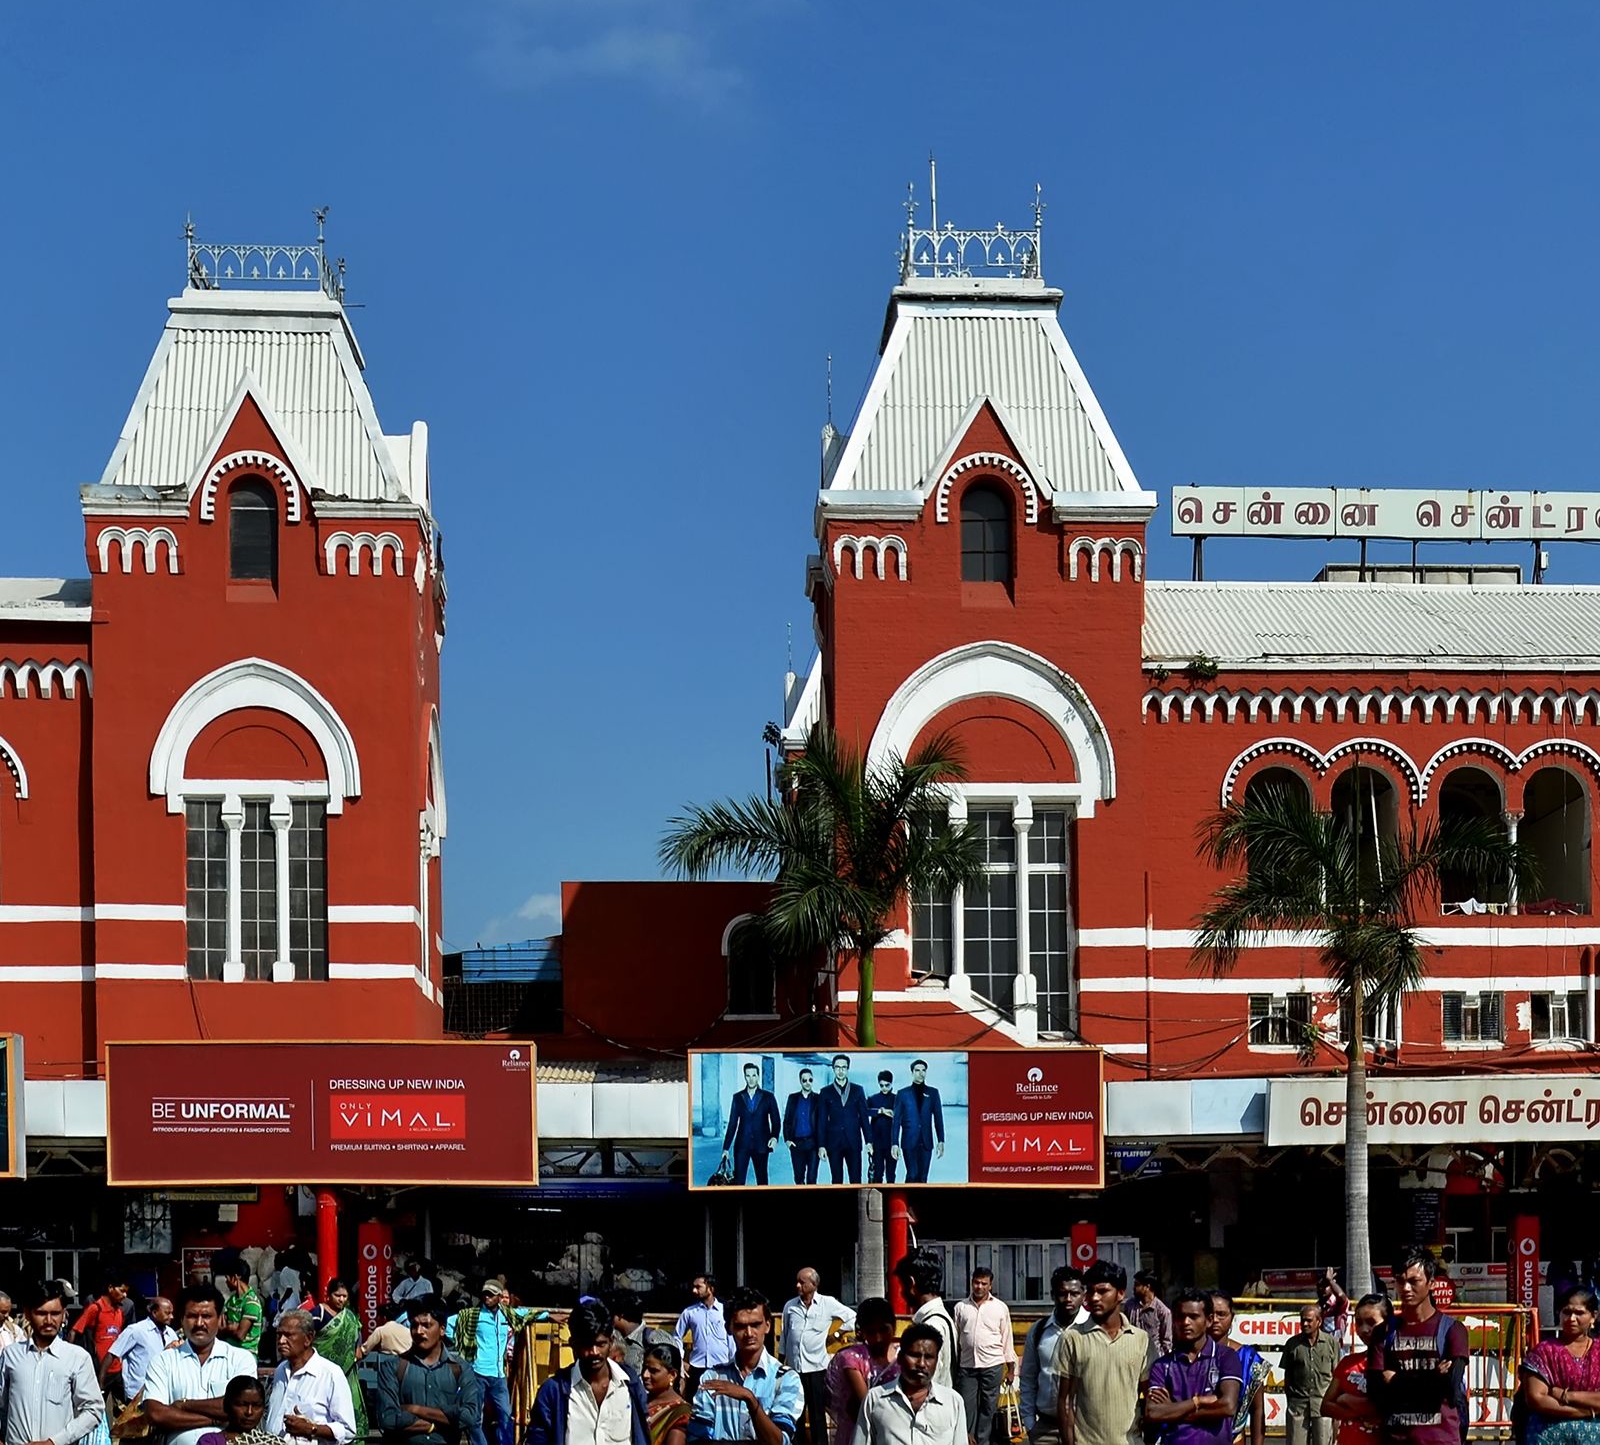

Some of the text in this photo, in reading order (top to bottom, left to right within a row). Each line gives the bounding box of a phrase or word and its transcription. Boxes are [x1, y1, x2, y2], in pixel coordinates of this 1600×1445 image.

[1176, 491, 1379, 527] சென்னை
[330, 1080, 465, 1089] DRESSING UP NEW INDIA
[1016, 1083, 1058, 1093] Reliance
[152, 1103, 290, 1119] BE UNFORMAL
[340, 1109, 451, 1126] VIMAL
[982, 1111, 1093, 1122] DRESSING UP NEW INDIA
[990, 1137, 1083, 1152] VIMAL
